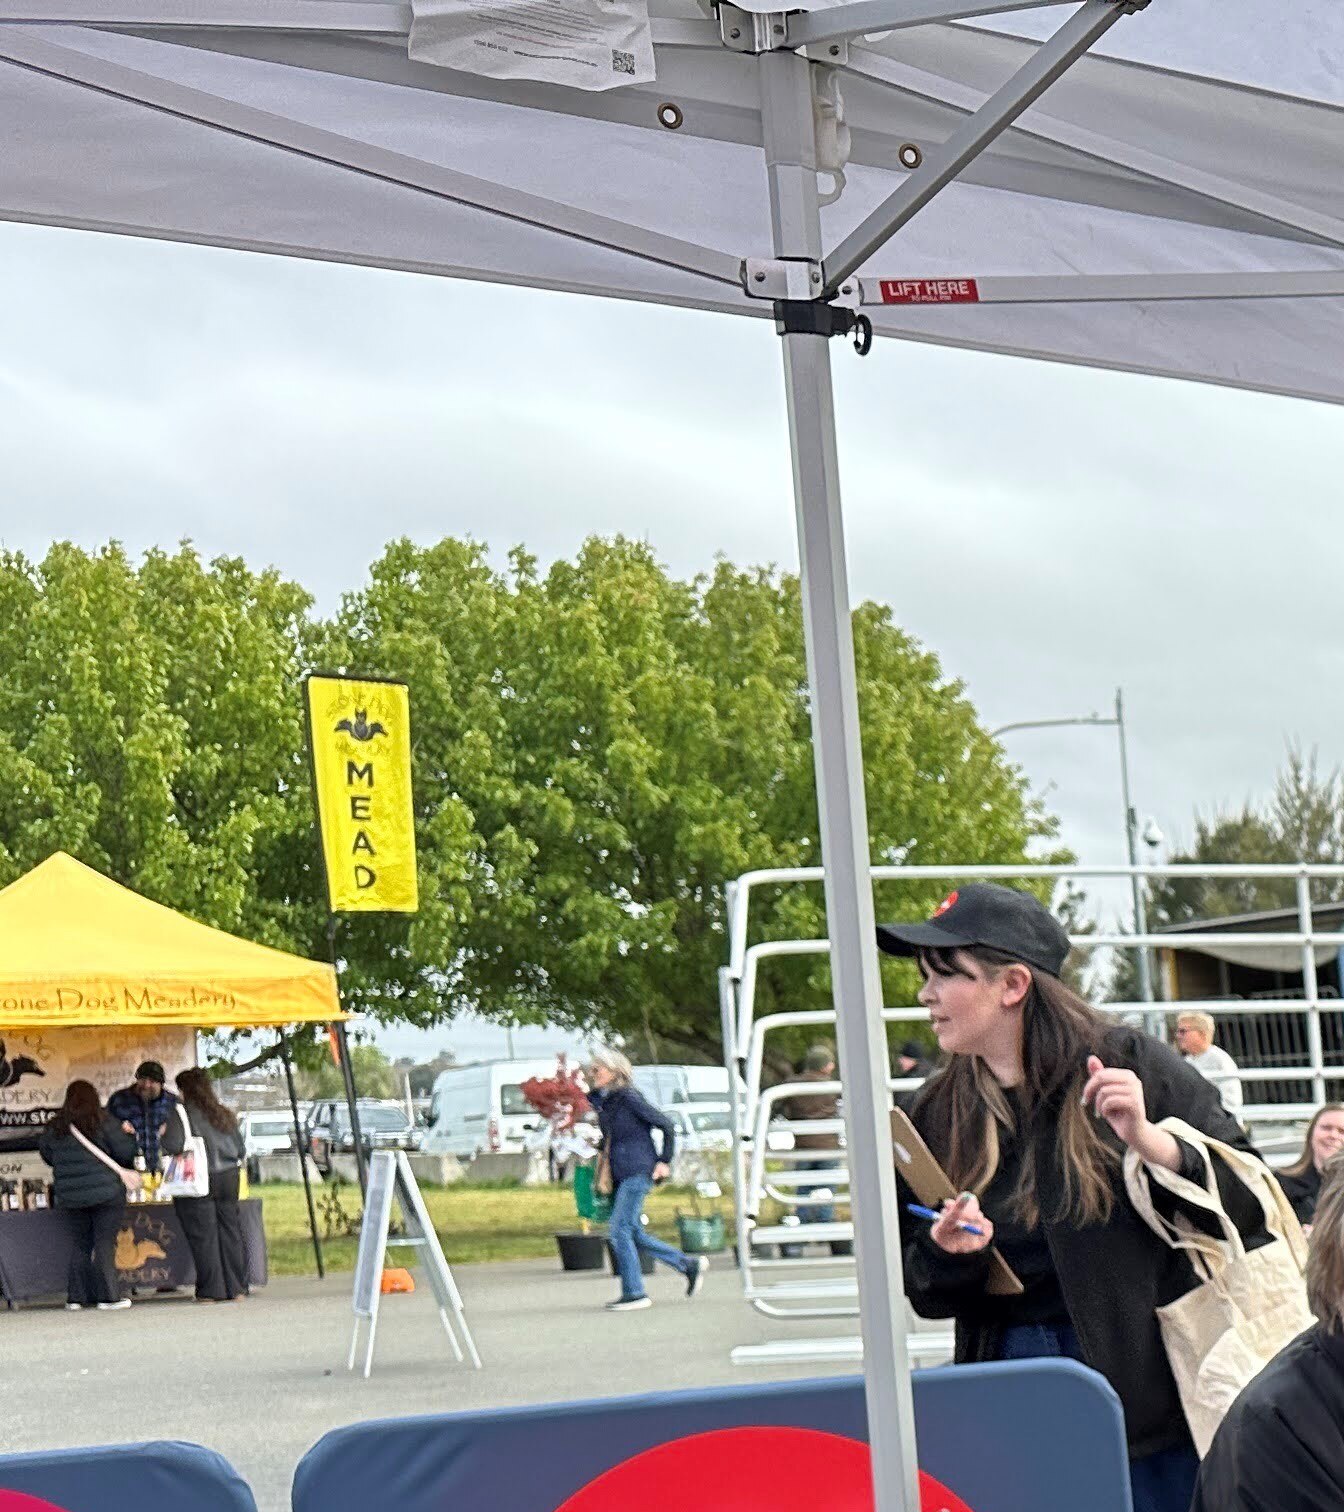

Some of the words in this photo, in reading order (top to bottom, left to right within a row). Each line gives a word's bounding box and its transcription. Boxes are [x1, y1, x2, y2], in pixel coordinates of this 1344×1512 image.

[888, 282, 921, 297] LIFT
[926, 281, 970, 296] HERE
[346, 760, 377, 889] MEAD
[1, 996, 48, 1011] one
[56, 986, 119, 1012] Dog
[124, 985, 237, 1011] Meadery
